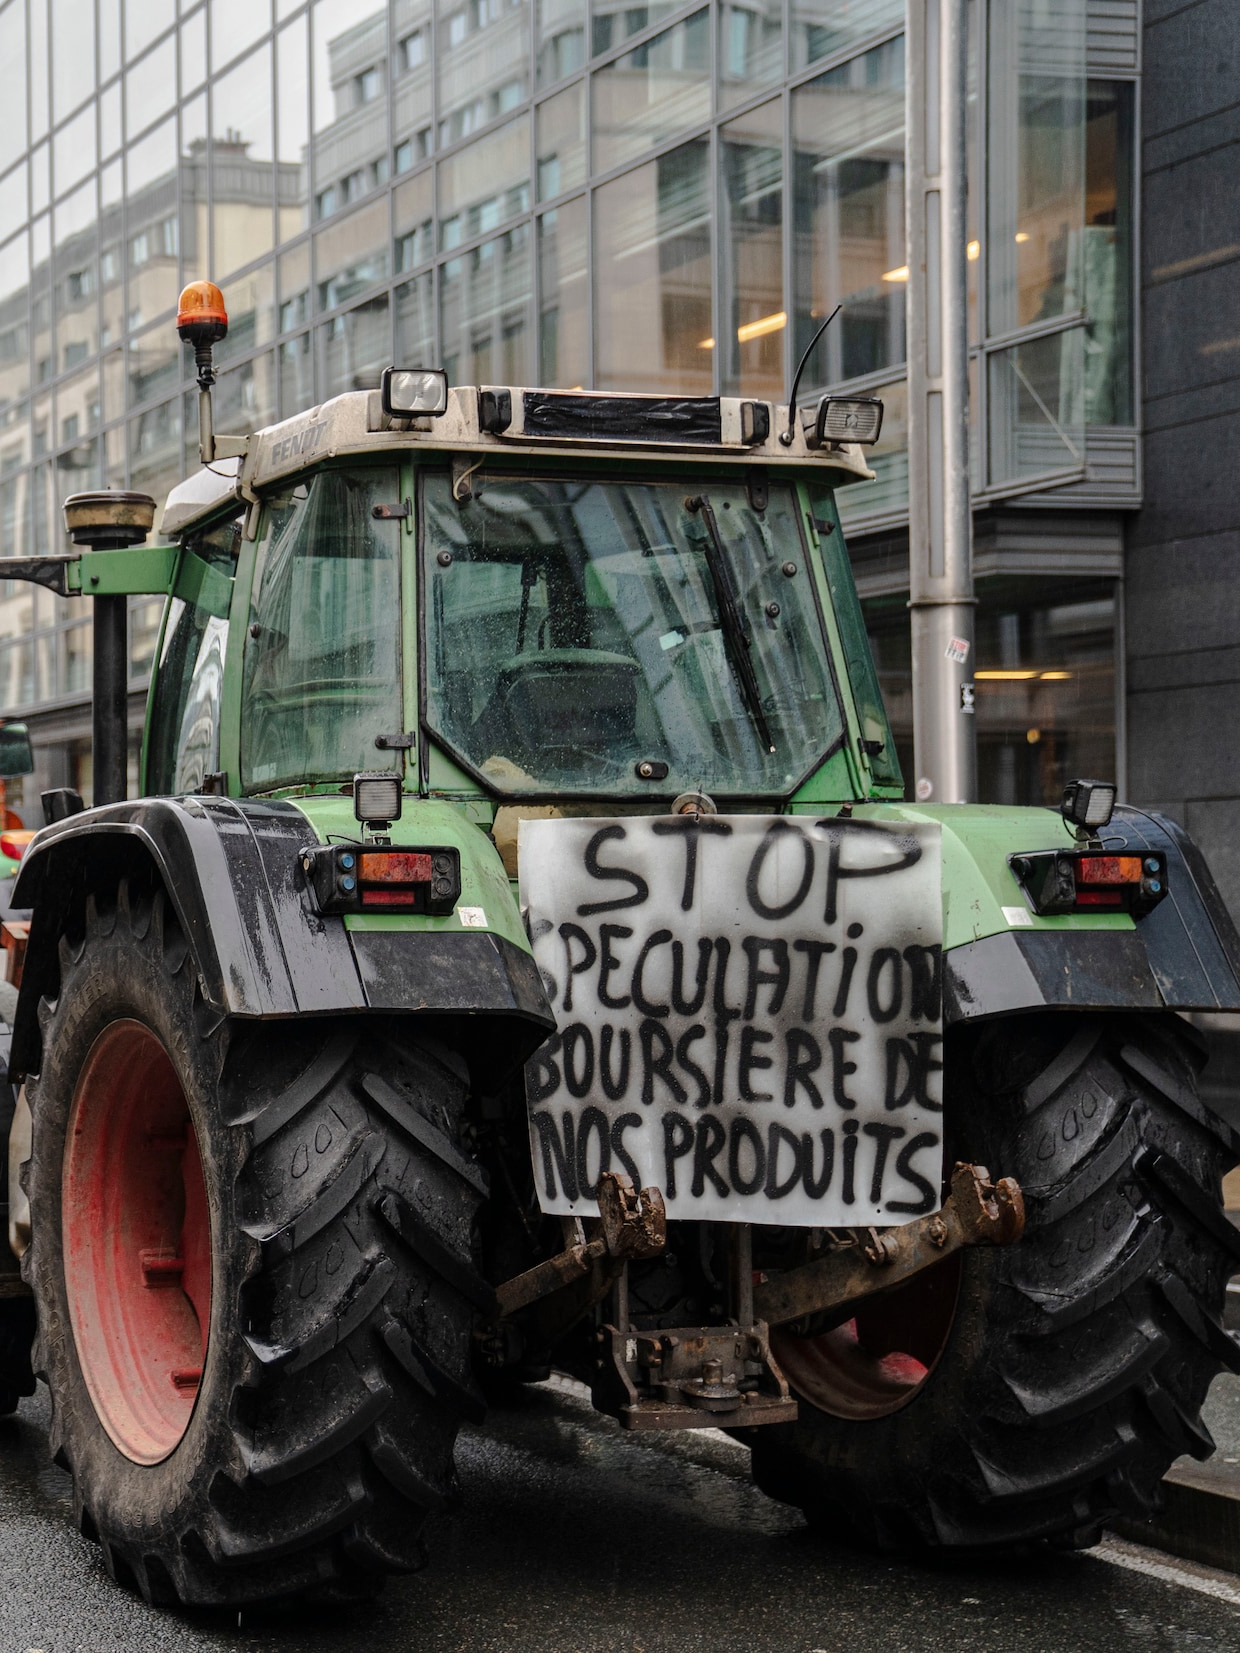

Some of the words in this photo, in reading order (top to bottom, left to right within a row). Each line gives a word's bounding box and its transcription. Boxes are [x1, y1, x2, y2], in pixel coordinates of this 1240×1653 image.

[272, 421, 328, 465] FENDT
[576, 819, 924, 925] STOP
[526, 1019, 861, 1110] BOURSIERE
[885, 1031, 943, 1112] DE
[530, 1107, 642, 1202] NOS
